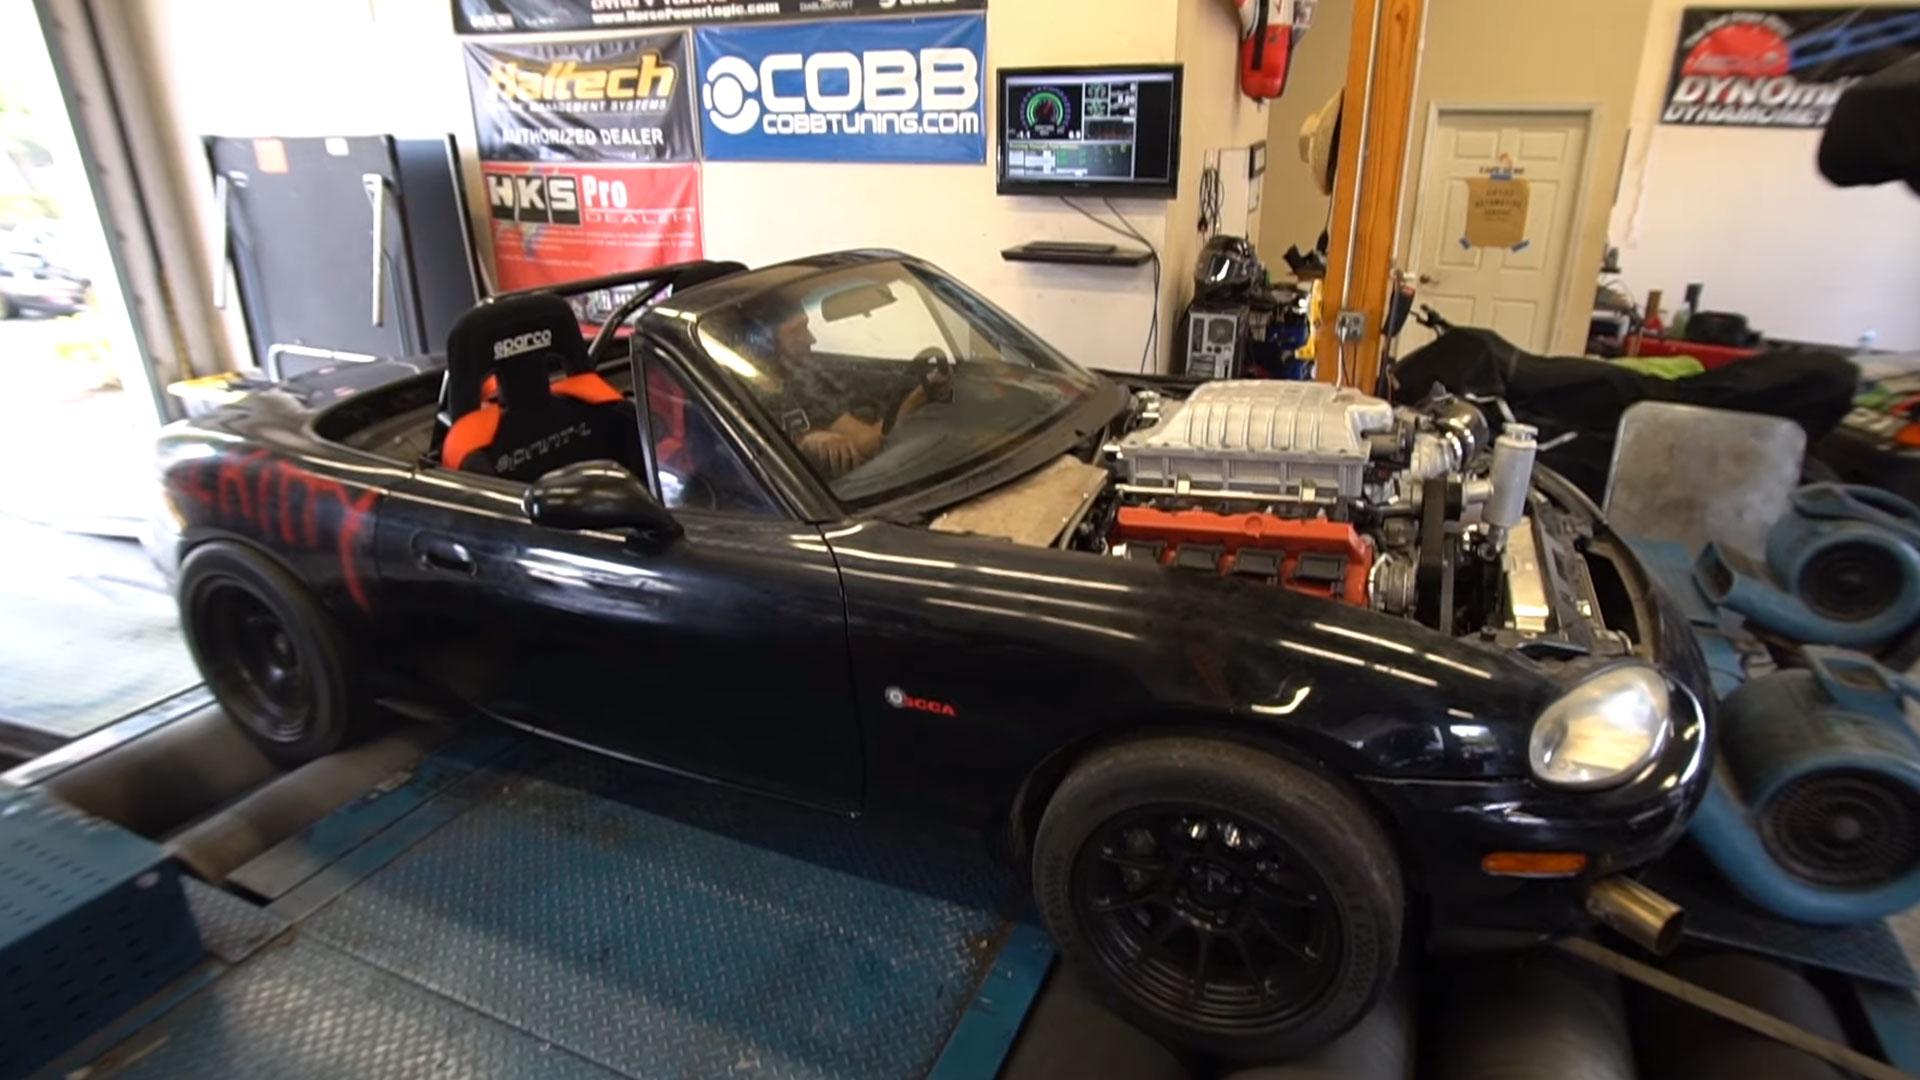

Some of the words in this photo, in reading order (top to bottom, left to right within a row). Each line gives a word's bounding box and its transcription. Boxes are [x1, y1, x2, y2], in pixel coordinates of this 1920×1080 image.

[759, 47, 979, 112] COBB
[610, 98, 667, 111] SYSTEMS
[762, 112, 979, 134] COBBTUNING.COM
[501, 127, 598, 146] AUTHORIZED
[600, 128, 664, 146] DEALER
[486, 175, 578, 211] HKS
[581, 174, 629, 210] Pro
[493, 328, 552, 360] sparco
[904, 695, 957, 717] SCCA
